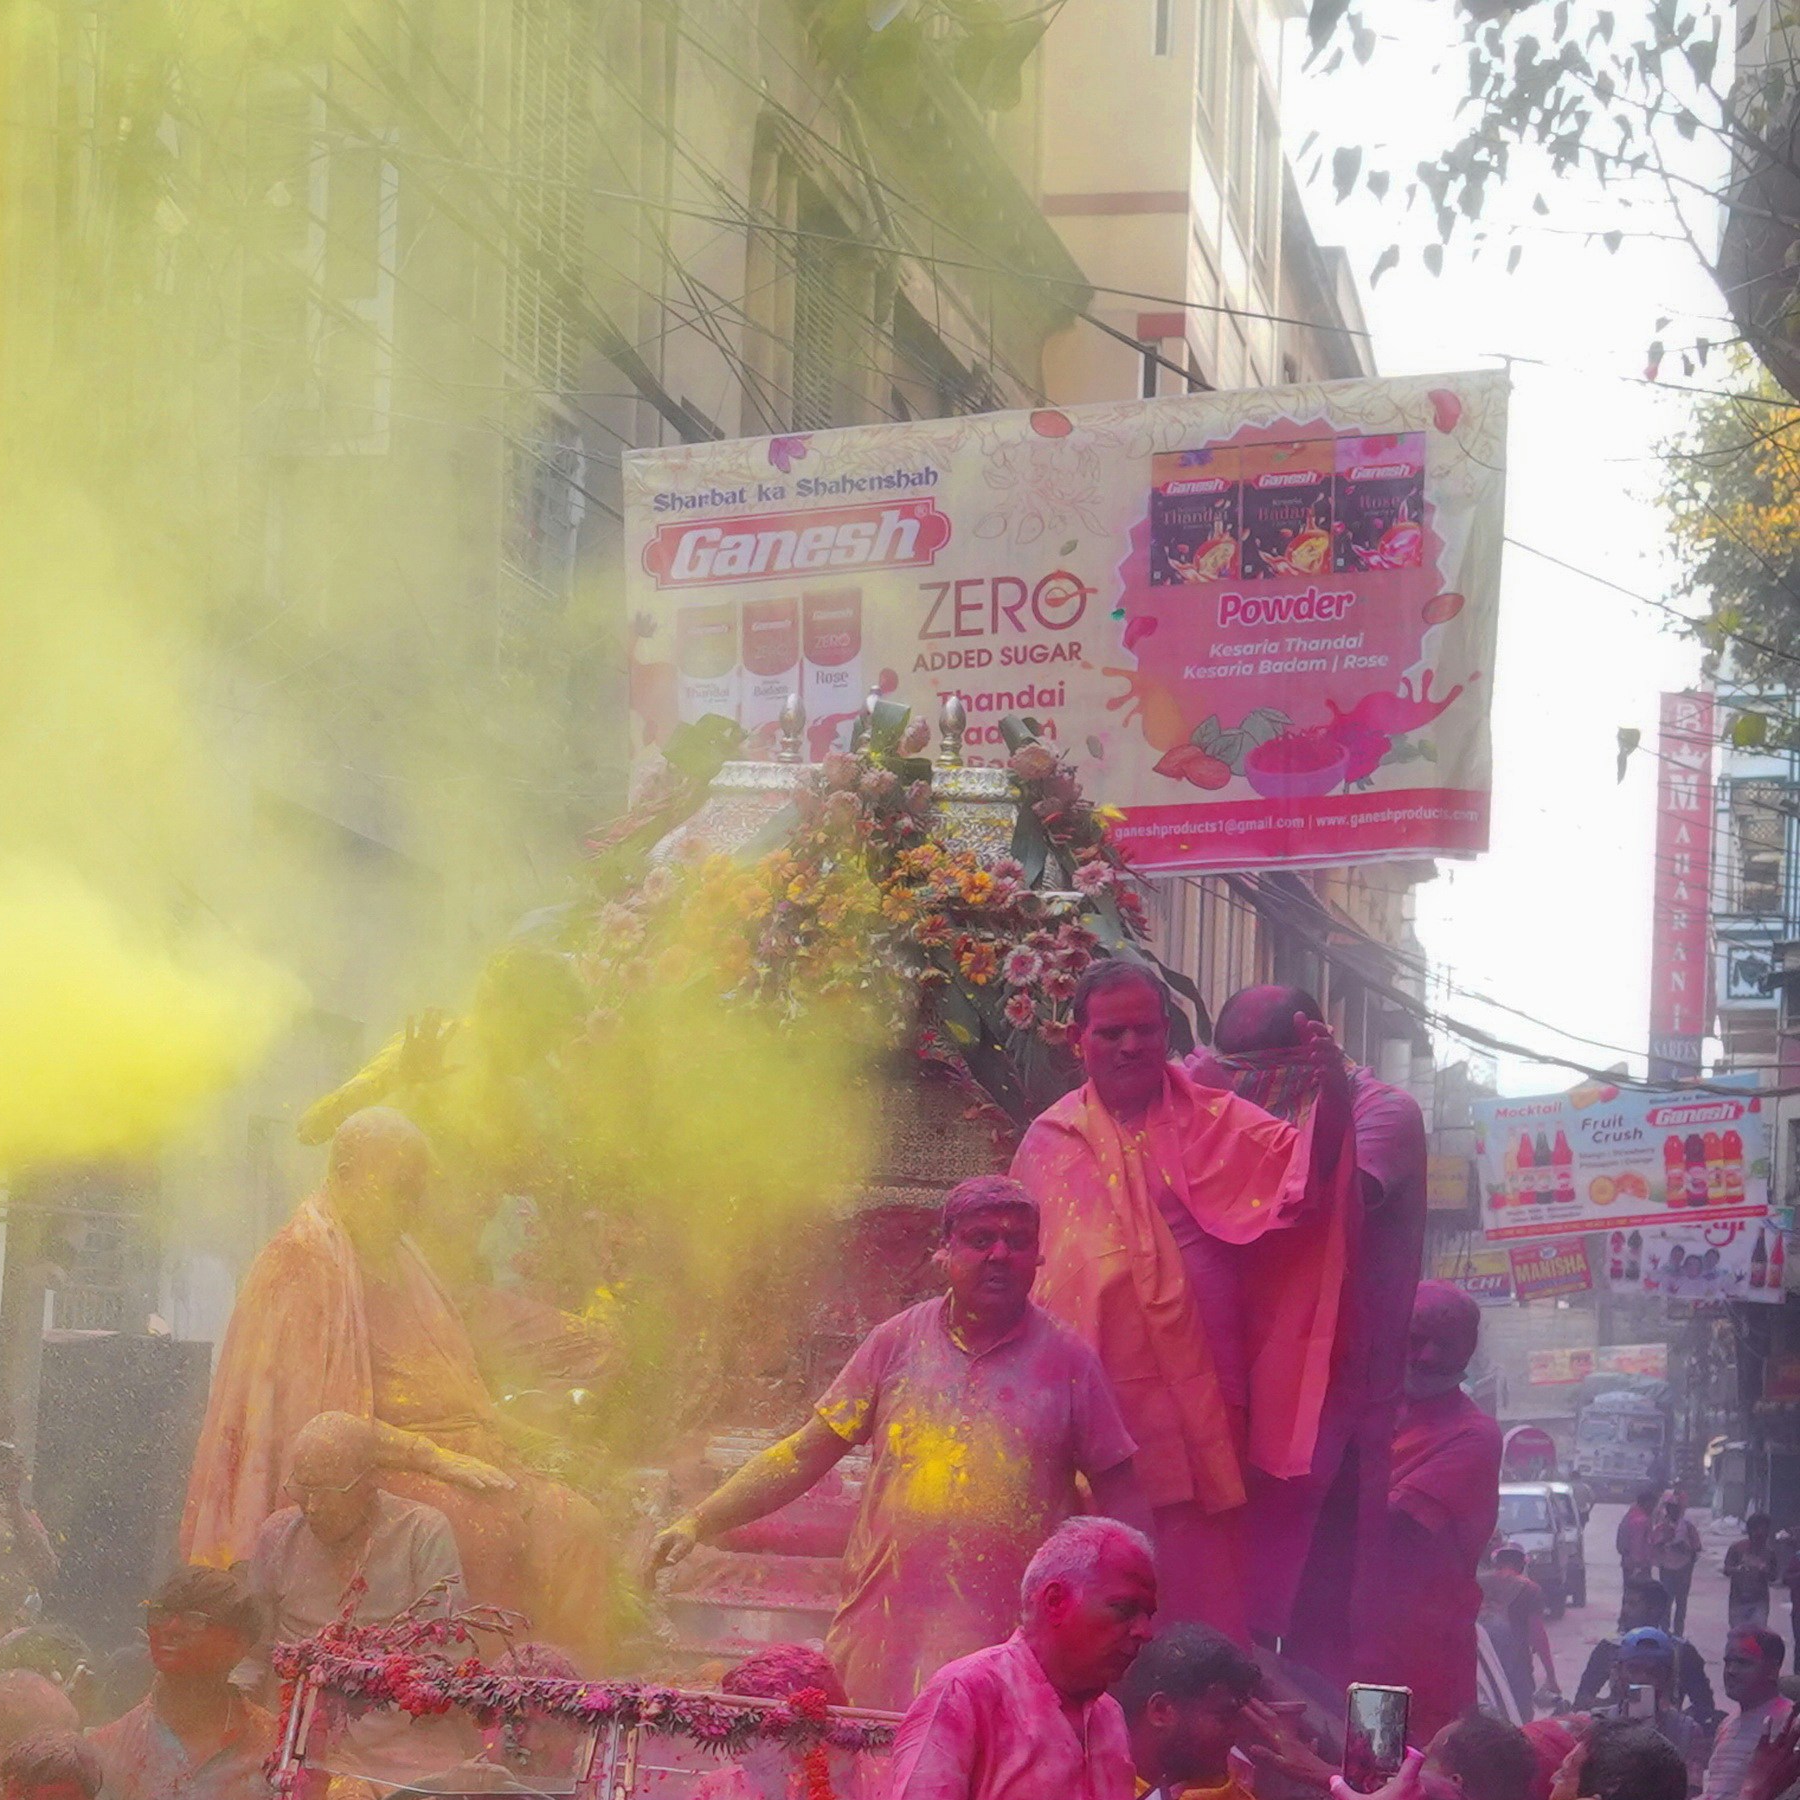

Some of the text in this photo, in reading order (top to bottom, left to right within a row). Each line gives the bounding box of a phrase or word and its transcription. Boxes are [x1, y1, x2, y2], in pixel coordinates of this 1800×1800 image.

[1258, 471, 1318, 488] Ganesh
[1350, 463, 1410, 481] Ganesh
[653, 466, 939, 513] Sharbat ka Shahenshah
[1166, 478, 1225, 494] Ganesh
[669, 509, 922, 580] Ganesh
[918, 571, 1090, 640] ZERO
[1218, 586, 1355, 628] Powder
[913, 641, 1082, 672] ADDED SUGAR
[1209, 632, 1365, 658] Kesaria Thandai
[815, 670, 849, 685] Rose
[1183, 654, 1389, 680] Kesaria Badam Rose
[936, 680, 1065, 713] Thandai
[1115, 816, 1305, 840] ganeshproducts1@gmail.com
[1496, 1102, 1563, 1120] Mocktail
[1582, 1114, 1624, 1131] Fruit
[1655, 1104, 1737, 1126] Ganesh
[1592, 1127, 1643, 1143] Crush
[1516, 1253, 1587, 1283] MANISHA
